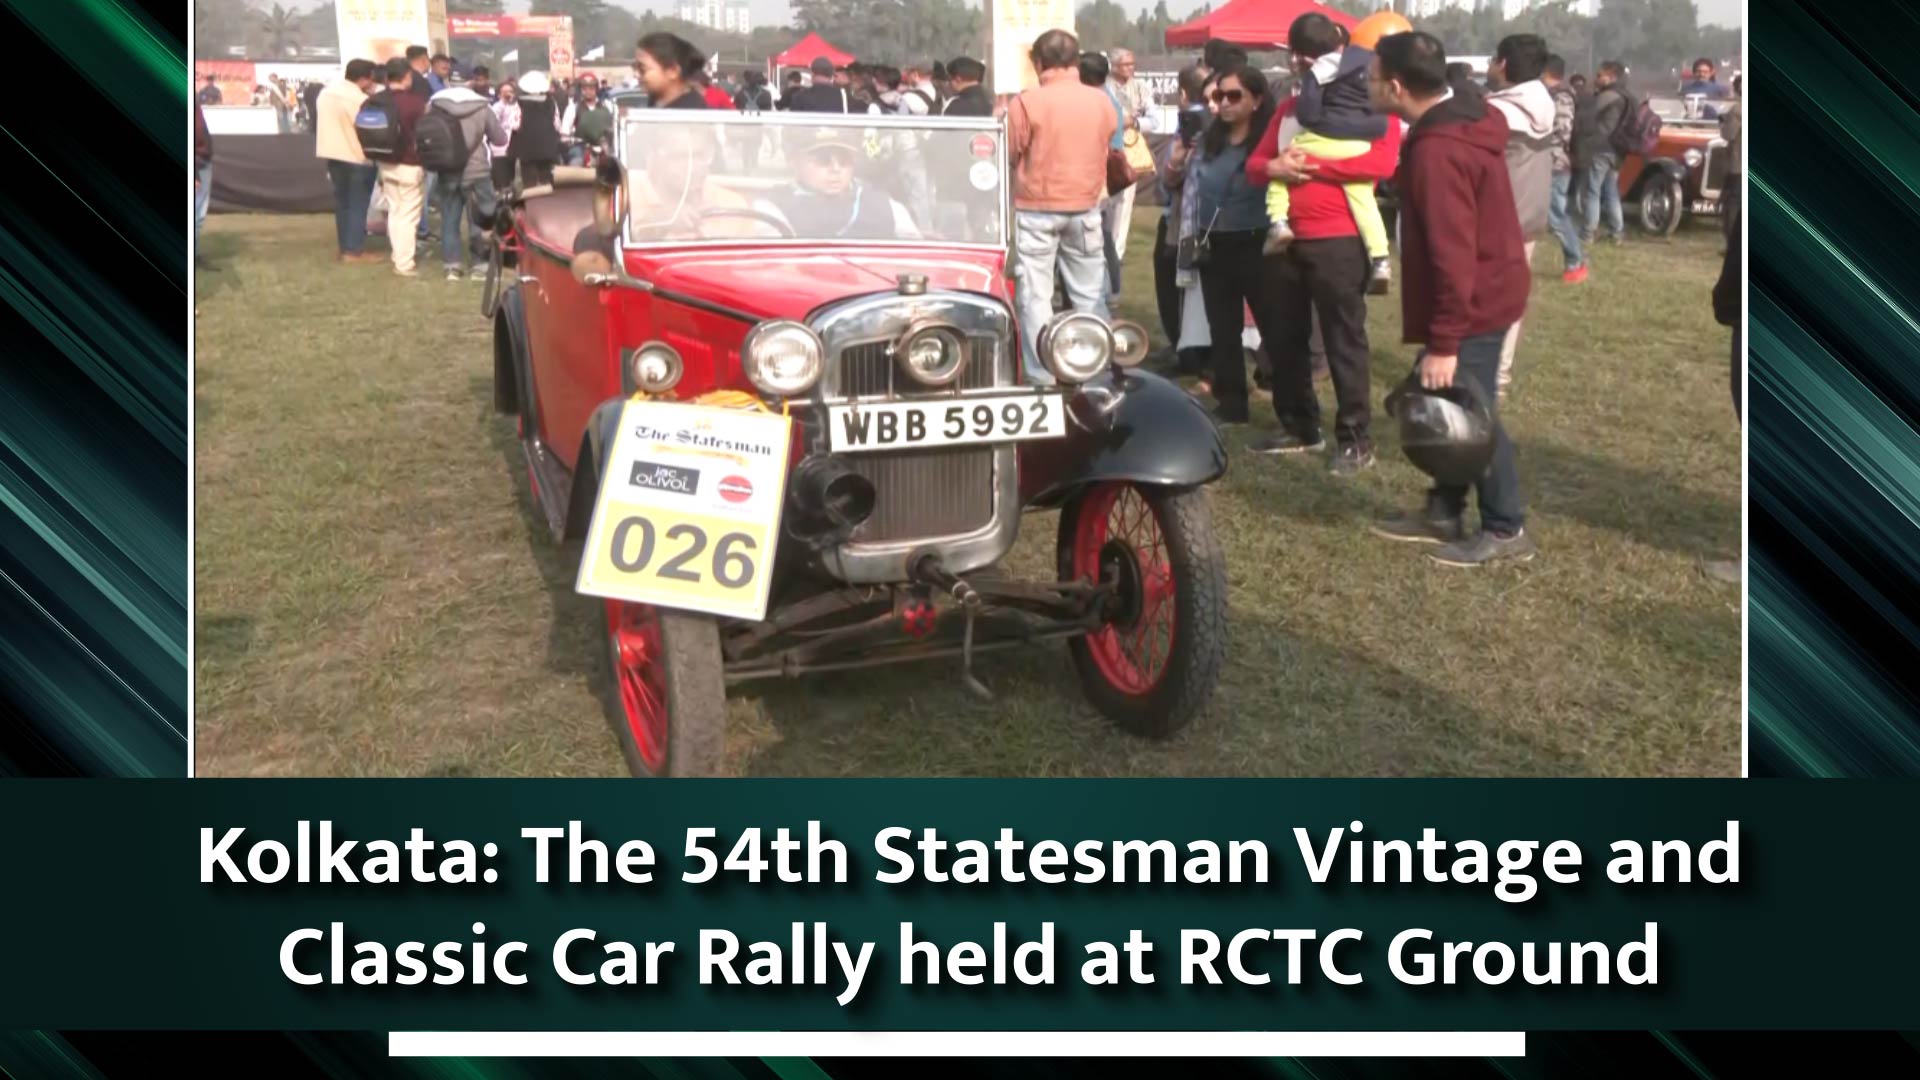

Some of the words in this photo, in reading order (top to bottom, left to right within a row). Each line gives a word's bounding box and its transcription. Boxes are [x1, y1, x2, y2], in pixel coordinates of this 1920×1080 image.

[635, 425, 670, 441] The
[676, 429, 772, 456] Statesman
[842, 408, 927, 446] WBB
[943, 402, 1050, 439] 5992
[636, 472, 690, 492] OLIVOL
[610, 516, 757, 589] 026
